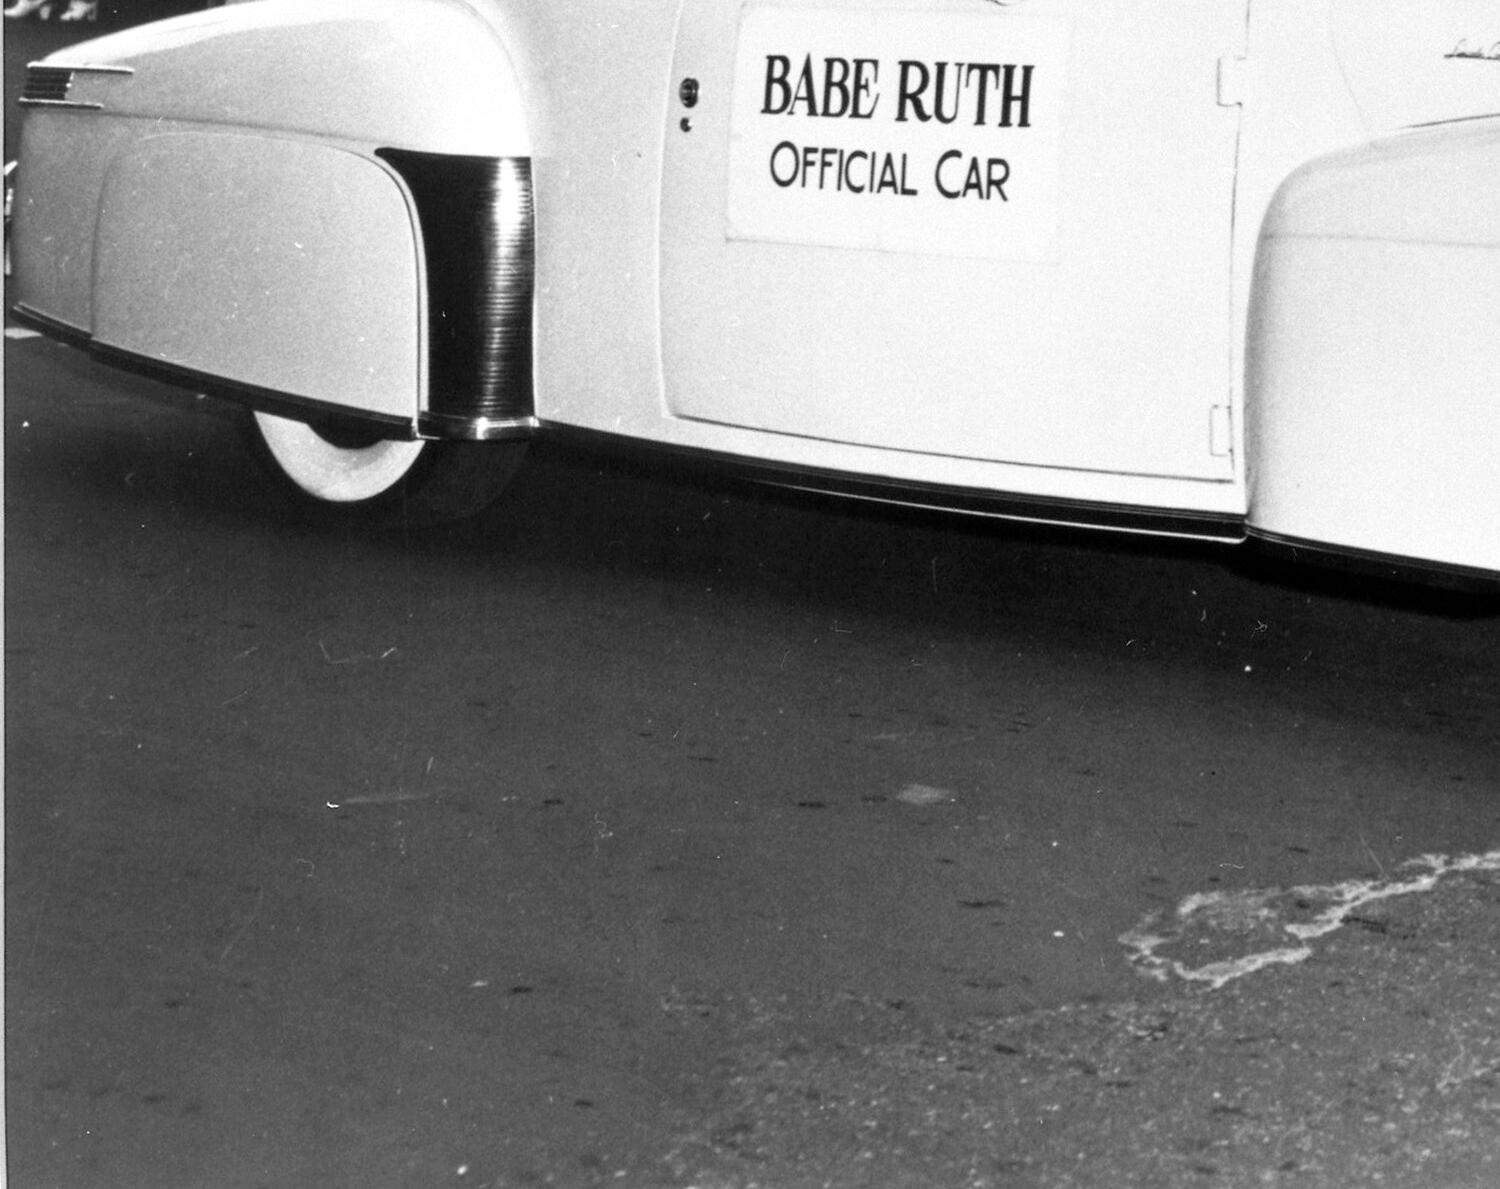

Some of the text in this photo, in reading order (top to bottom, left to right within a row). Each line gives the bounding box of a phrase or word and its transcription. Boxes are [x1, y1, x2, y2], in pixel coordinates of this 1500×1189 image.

[760, 51, 1035, 128] BABE RUTH
[769, 140, 1011, 202] OFFICIAL CAR
